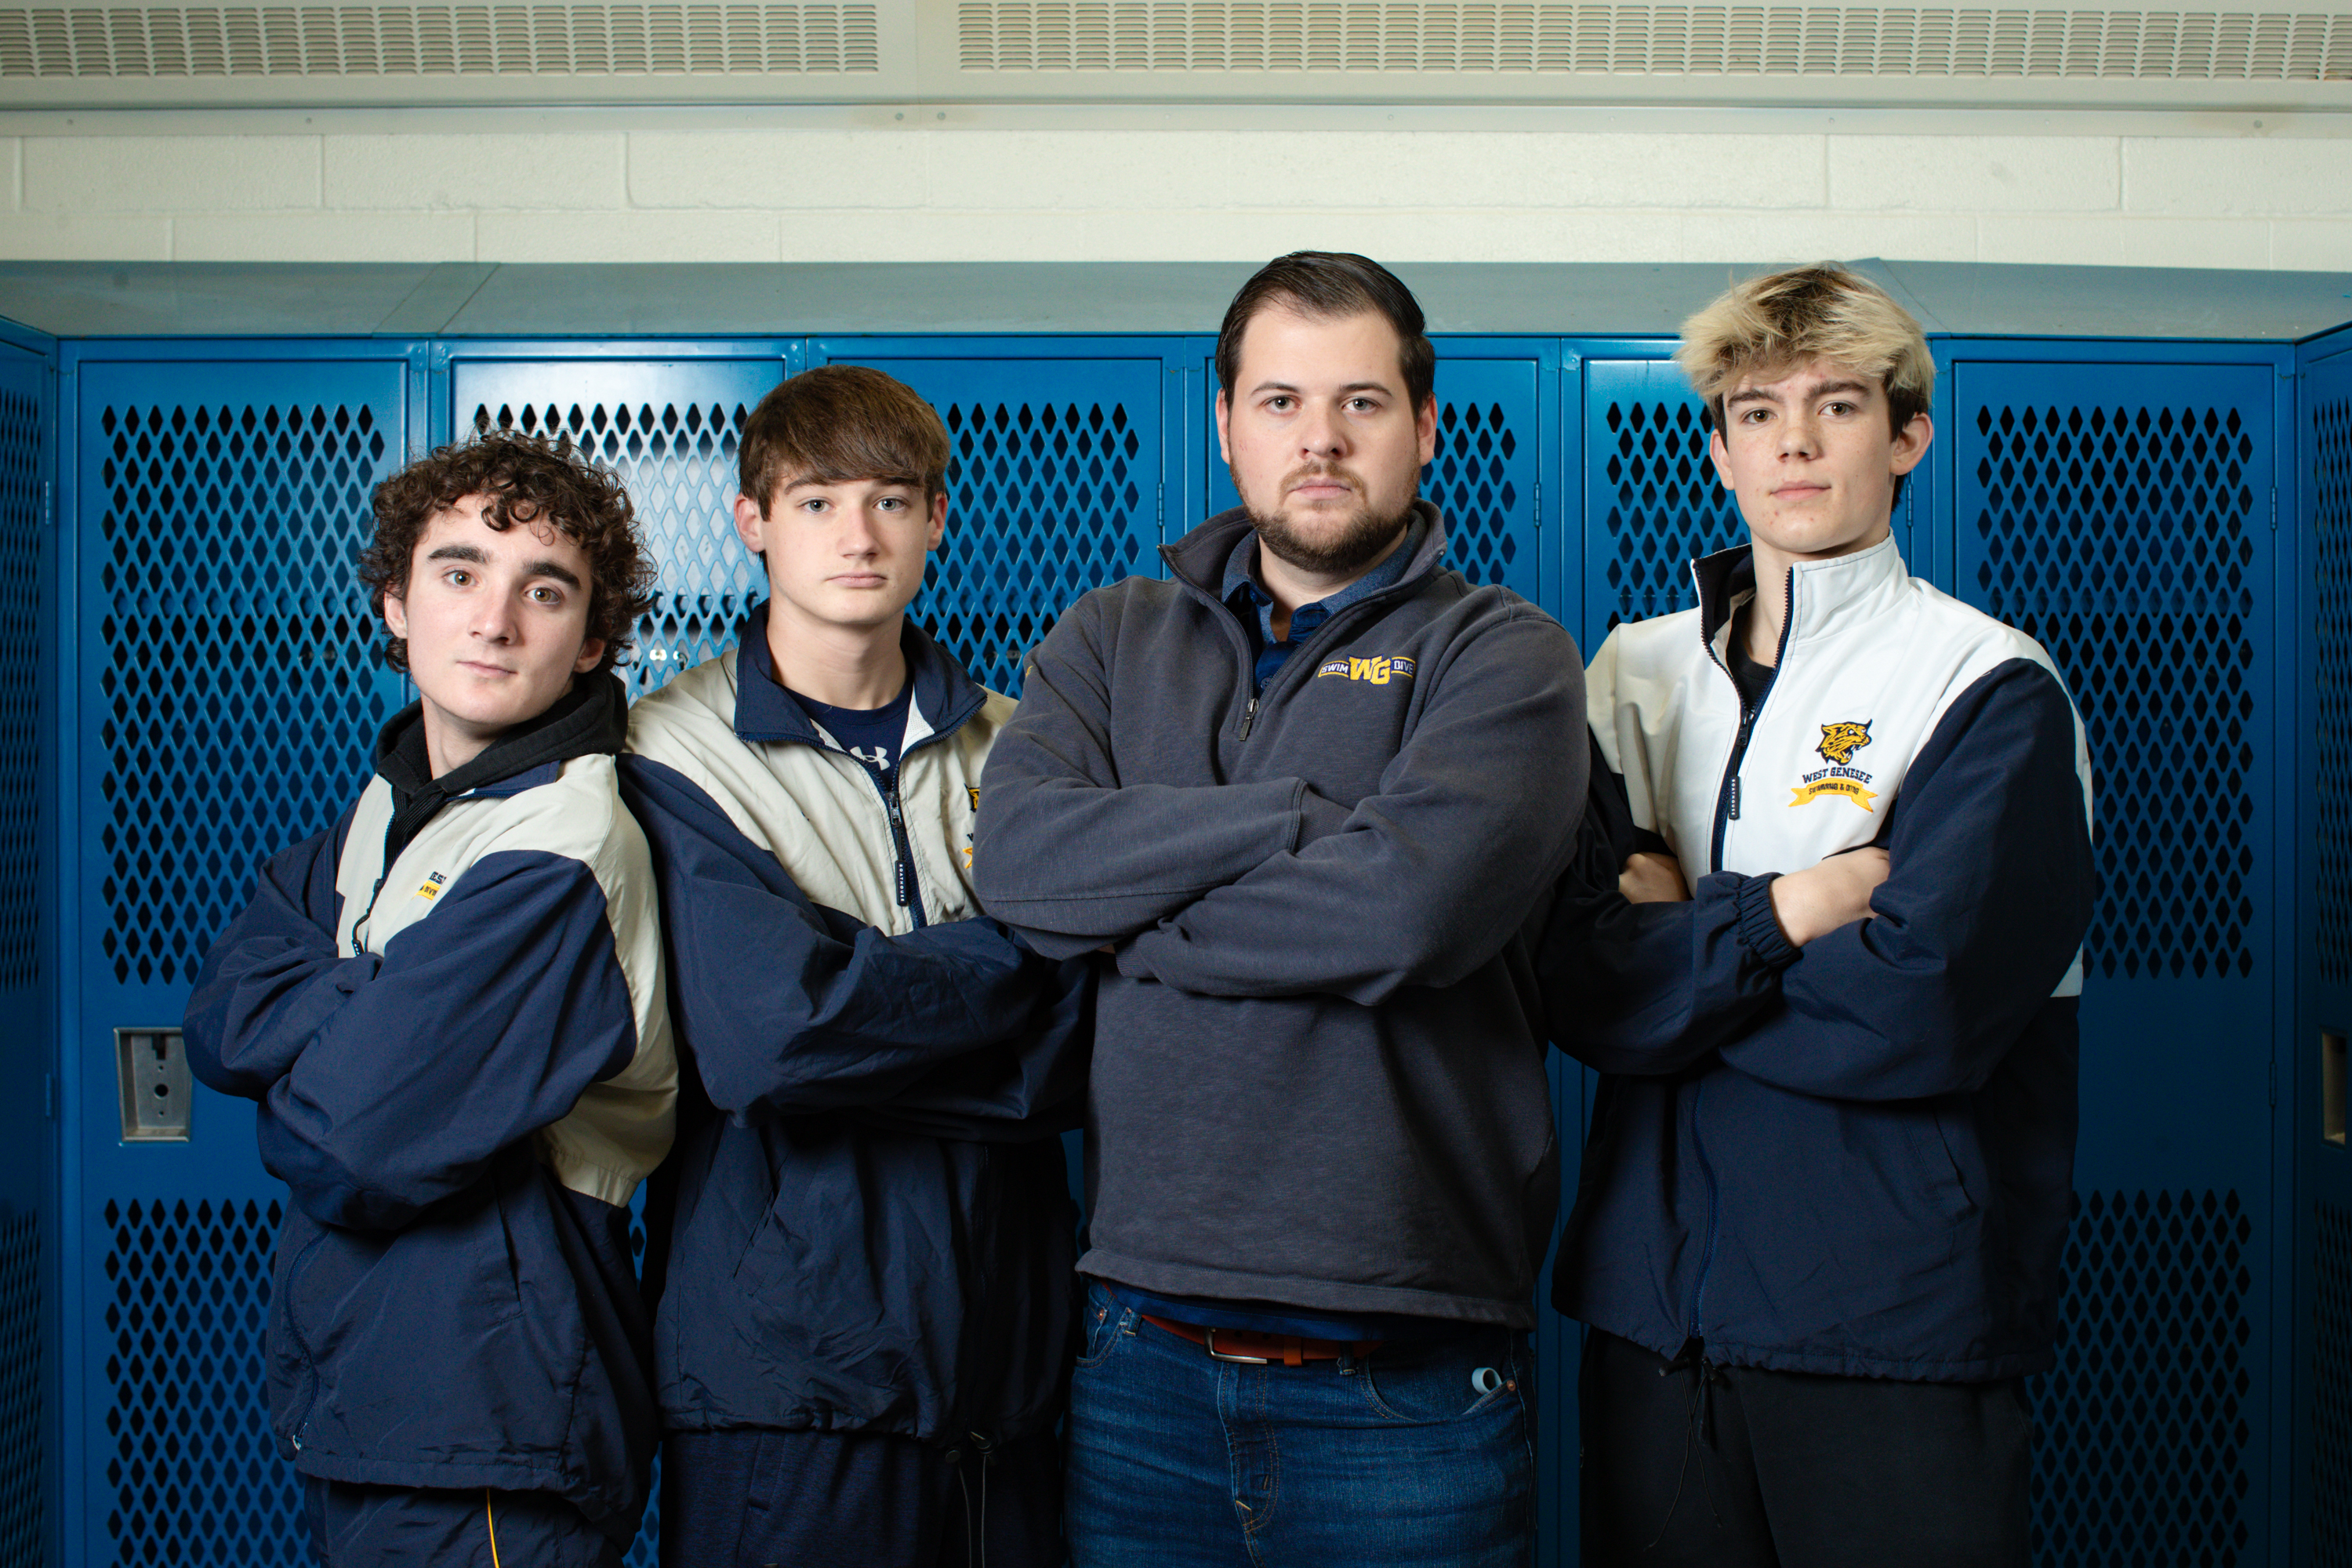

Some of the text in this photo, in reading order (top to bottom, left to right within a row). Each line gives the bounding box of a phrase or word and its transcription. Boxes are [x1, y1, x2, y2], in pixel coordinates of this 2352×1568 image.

[1321, 655, 1414, 685] SWIM WG DIVE
[1802, 767, 1873, 784] WEST GENESEE
